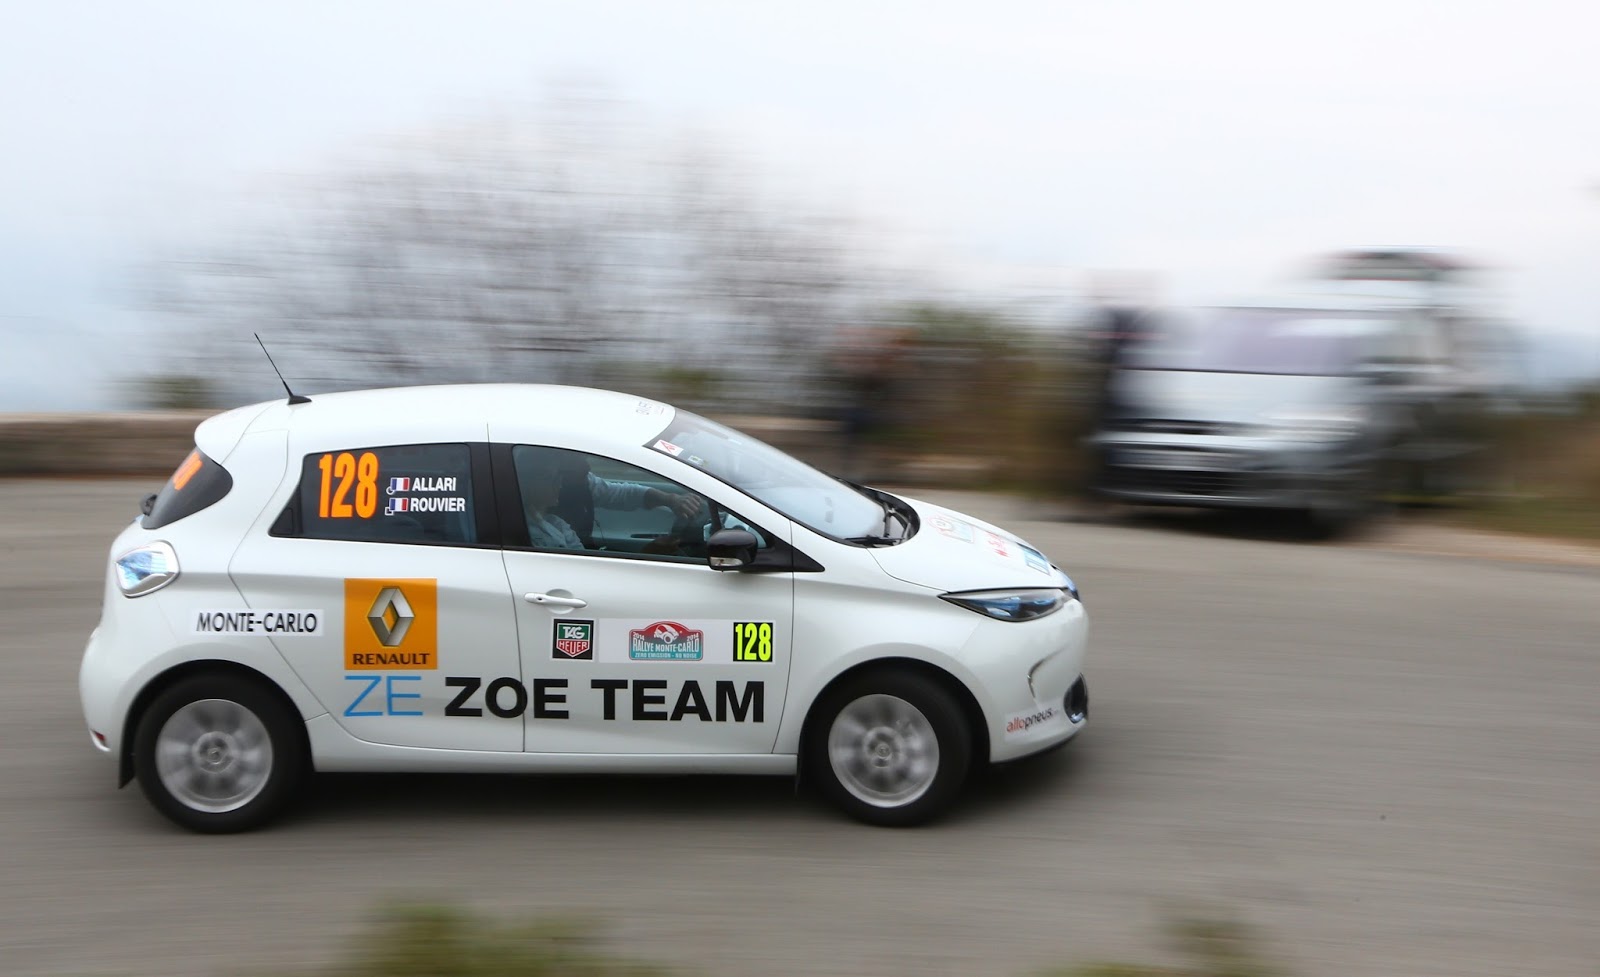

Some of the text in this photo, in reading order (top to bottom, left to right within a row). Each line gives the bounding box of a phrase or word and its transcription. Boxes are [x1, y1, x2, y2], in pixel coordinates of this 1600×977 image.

[319, 452, 379, 518] 128
[412, 477, 457, 492] ALLARI
[410, 497, 466, 512] ROUVIER
[196, 612, 318, 633] MONTE-CARLO
[562, 626, 586, 639] TAG
[632, 631, 645, 641] 2014
[686, 632, 699, 642] 2014
[558, 640, 588, 655] HEUER
[632, 637, 700, 653] RALLYE MONTE-CARLO
[735, 623, 772, 661] 128
[352, 653, 431, 665] RENAULT
[343, 675, 765, 723] ZE ZOE TEAM
